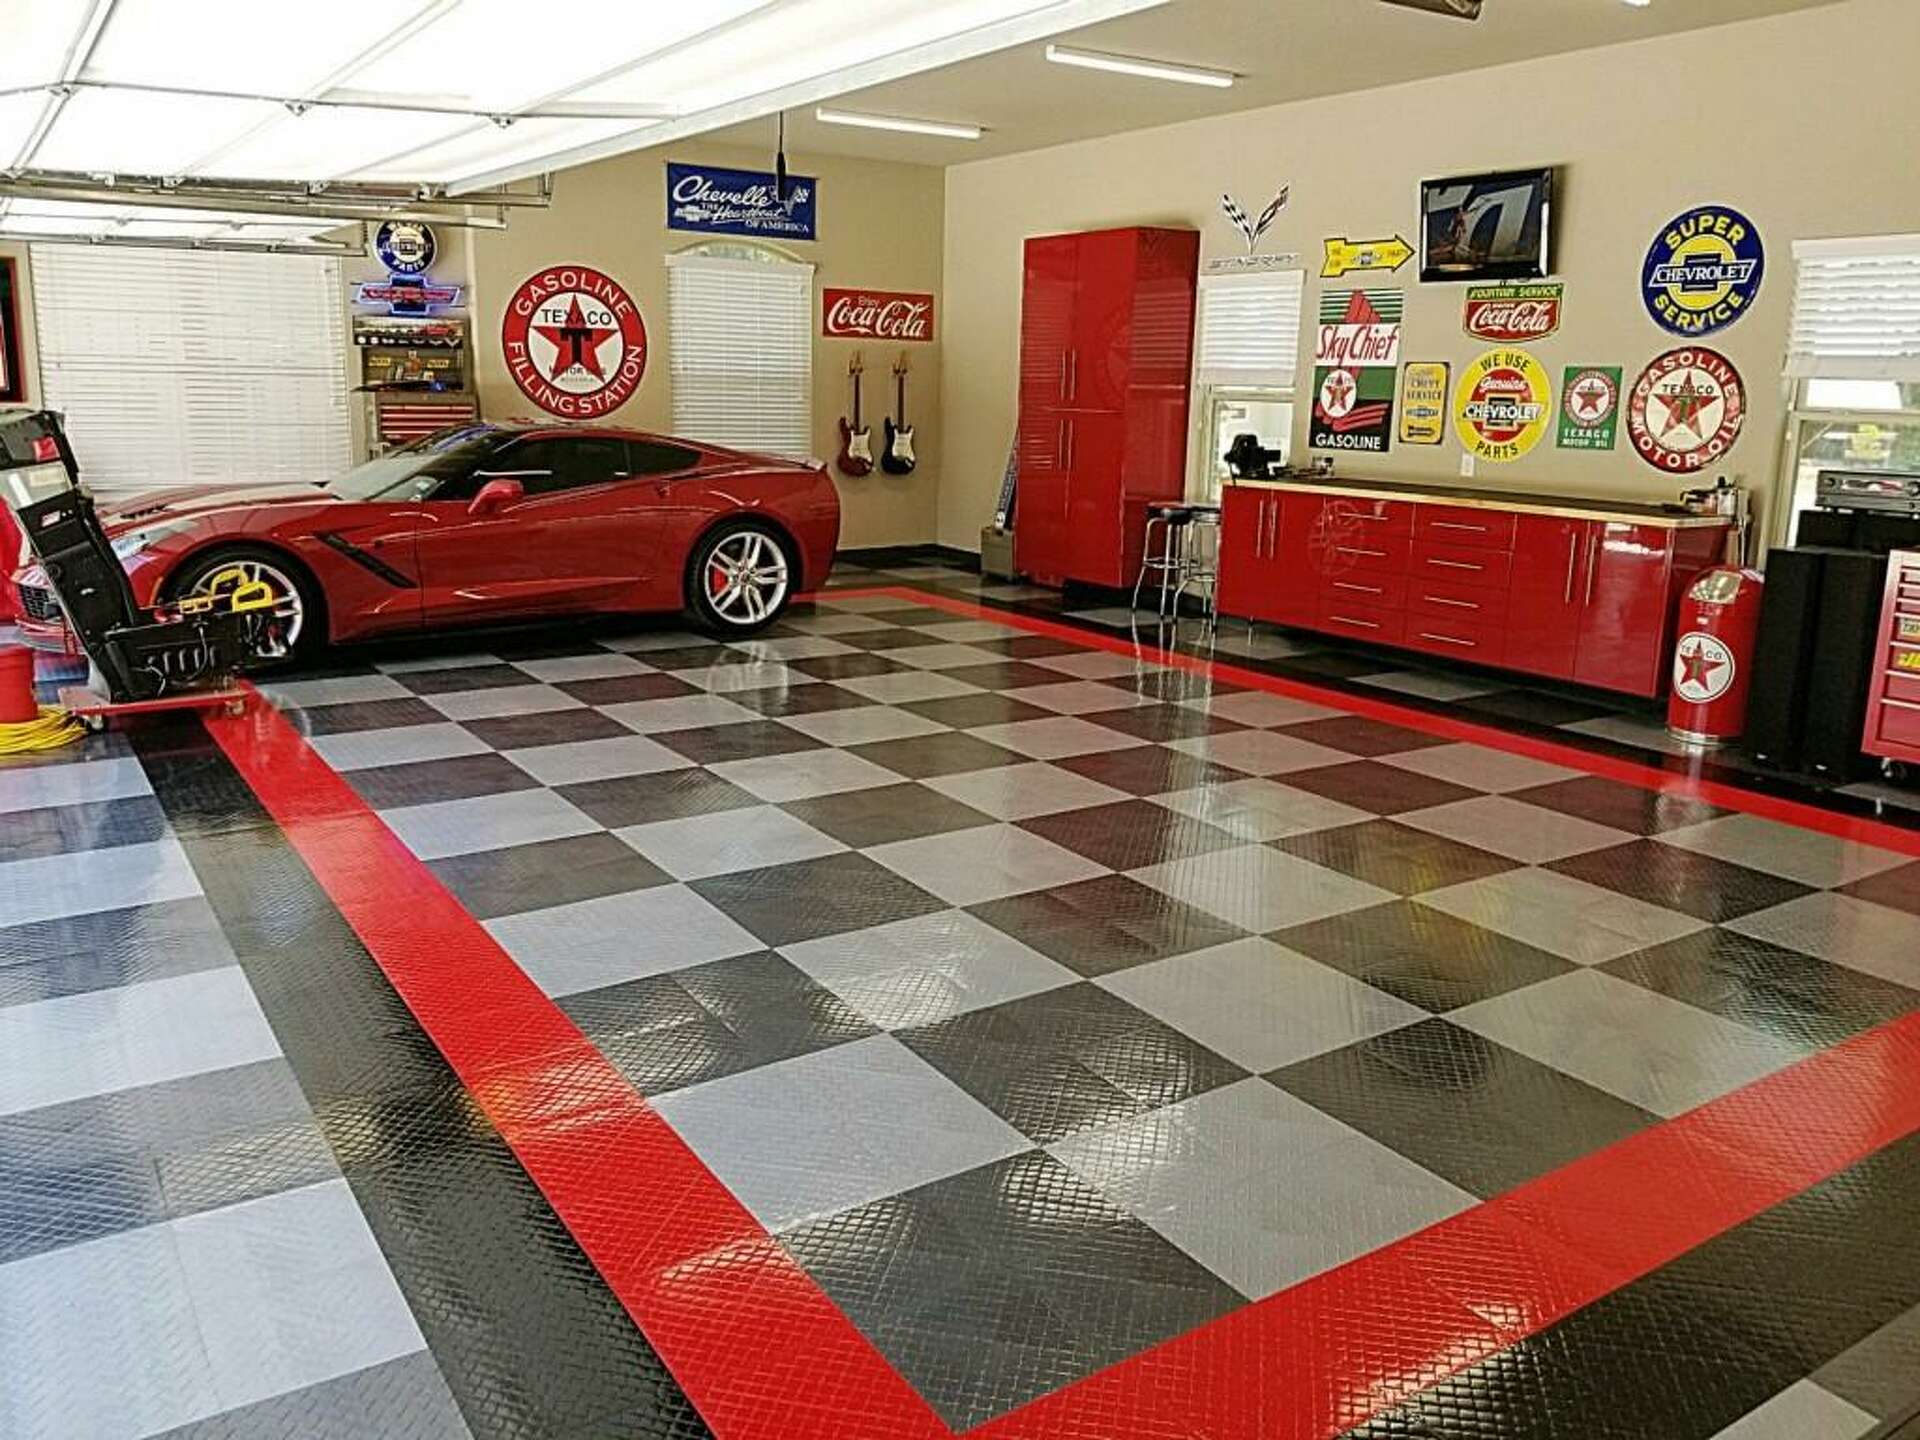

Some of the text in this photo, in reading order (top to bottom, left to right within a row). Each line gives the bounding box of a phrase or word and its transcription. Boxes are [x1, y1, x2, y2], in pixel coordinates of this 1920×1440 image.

[672, 175, 773, 207] Chevelle
[758, 220, 810, 233] AMERICA
[1665, 214, 1745, 250] SUPER
[1656, 265, 1748, 282] CHEVROLET
[515, 271, 633, 318] GASOLINE
[541, 309, 613, 326] TEXACO
[1655, 291, 1744, 330] SERVICE
[1315, 325, 1401, 365] Sky Chief
[1480, 353, 1531, 372] WE USE
[1637, 352, 1738, 397] GASOLINE
[508, 341, 643, 414] FILLING STATION
[1464, 404, 1540, 419] CHEVROLET
[1315, 433, 1381, 450] GASOLINE
[1564, 428, 1610, 439] TEXACO
[1633, 419, 1699, 467] MOTOR
[1475, 440, 1518, 459] PARTS
